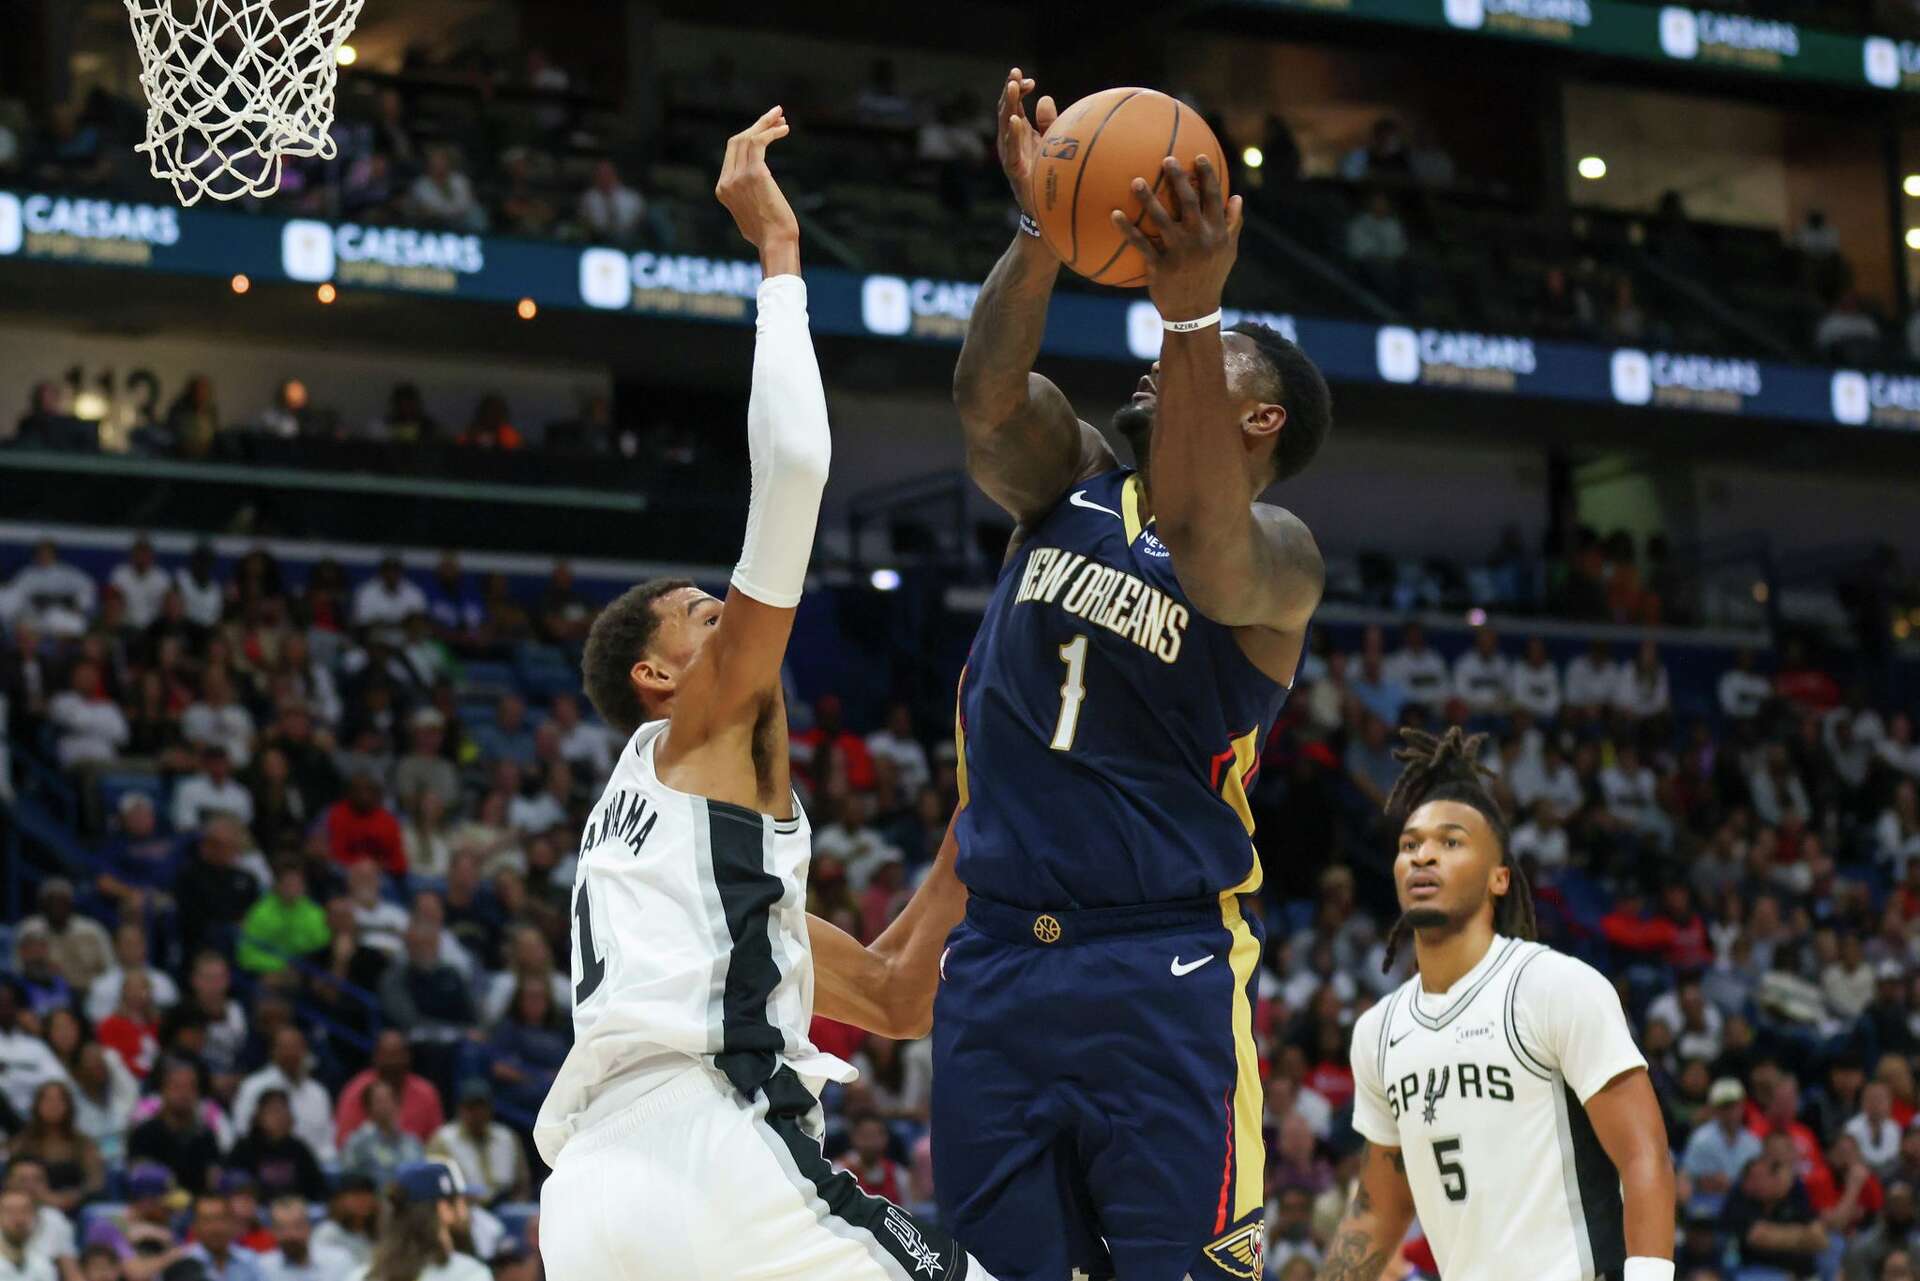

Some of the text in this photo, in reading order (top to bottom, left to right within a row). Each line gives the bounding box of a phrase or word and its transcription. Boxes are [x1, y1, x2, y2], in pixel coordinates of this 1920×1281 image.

[24, 194, 181, 246] CAESARS
[335, 222, 484, 273] CAESARS
[1419, 329, 1536, 375] CAESARS
[1653, 352, 1761, 396] CAESARS
[1014, 547, 1190, 664] NEW ORLEANS
[1050, 634, 1089, 752] 1
[1387, 1063, 1514, 1126] SPURS
[1431, 1133, 1468, 1204] 5
